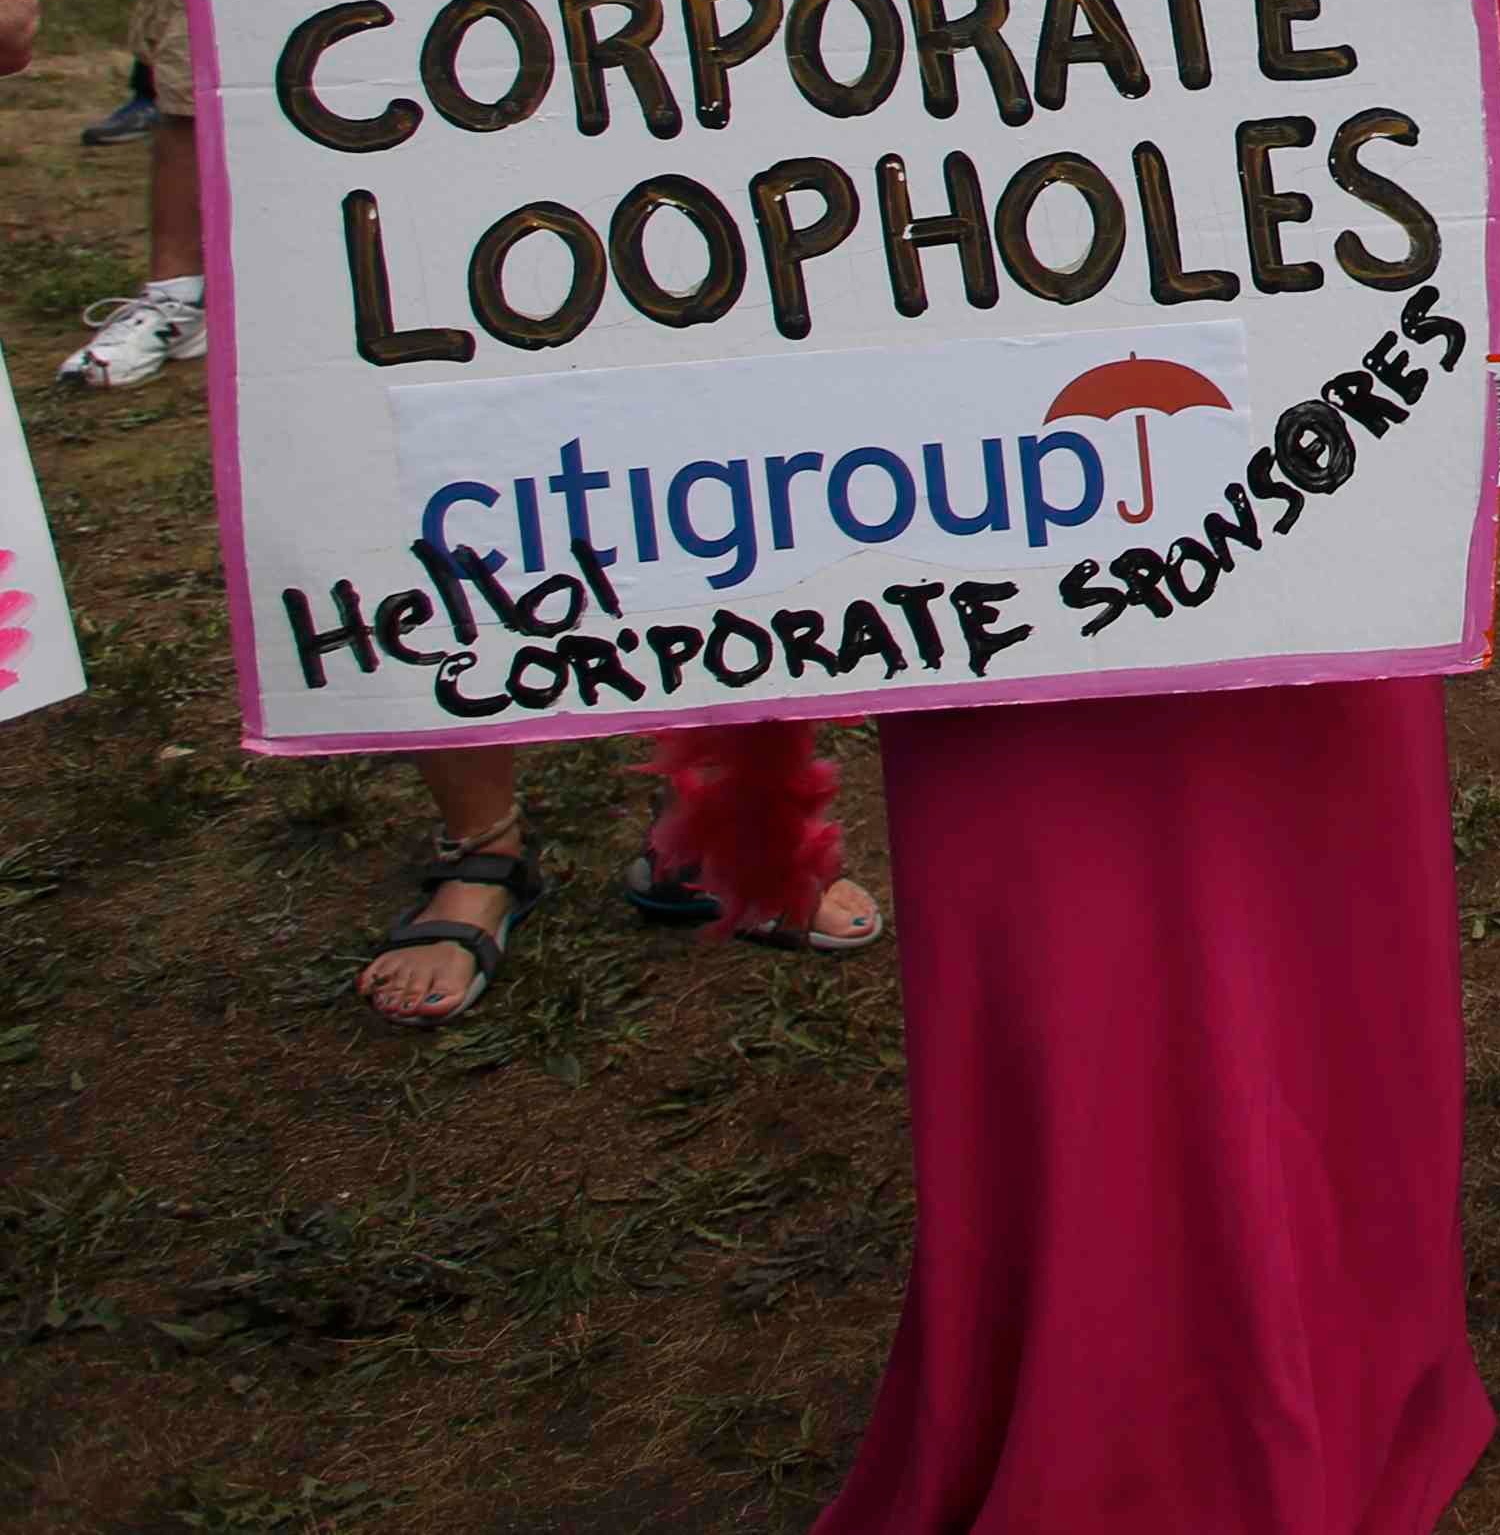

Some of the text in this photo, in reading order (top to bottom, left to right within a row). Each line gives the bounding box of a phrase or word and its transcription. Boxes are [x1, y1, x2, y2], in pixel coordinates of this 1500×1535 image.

[344, 107, 1441, 364] LOOPHOLES
[421, 428, 1105, 589] citigroup
[434, 576, 1033, 718] CORPORATE
